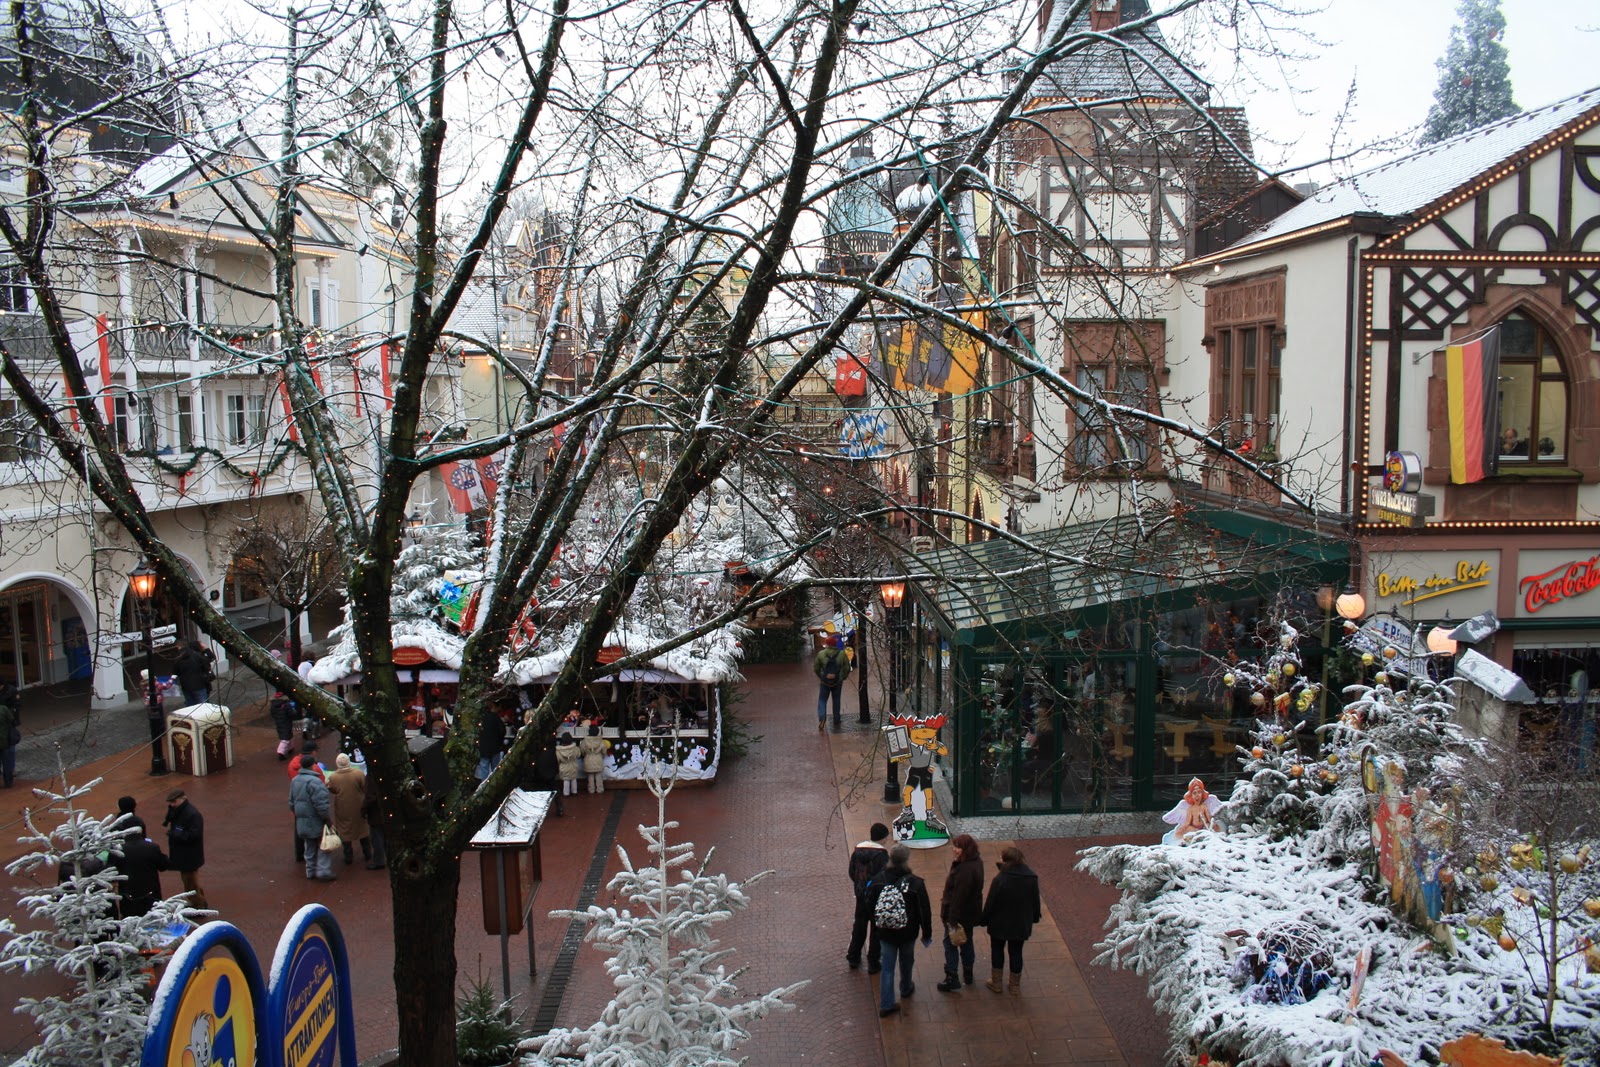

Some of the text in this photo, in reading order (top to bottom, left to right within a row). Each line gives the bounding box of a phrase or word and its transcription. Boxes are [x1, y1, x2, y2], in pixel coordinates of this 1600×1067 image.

[1378, 560, 1493, 597] Bitte ein Bit
